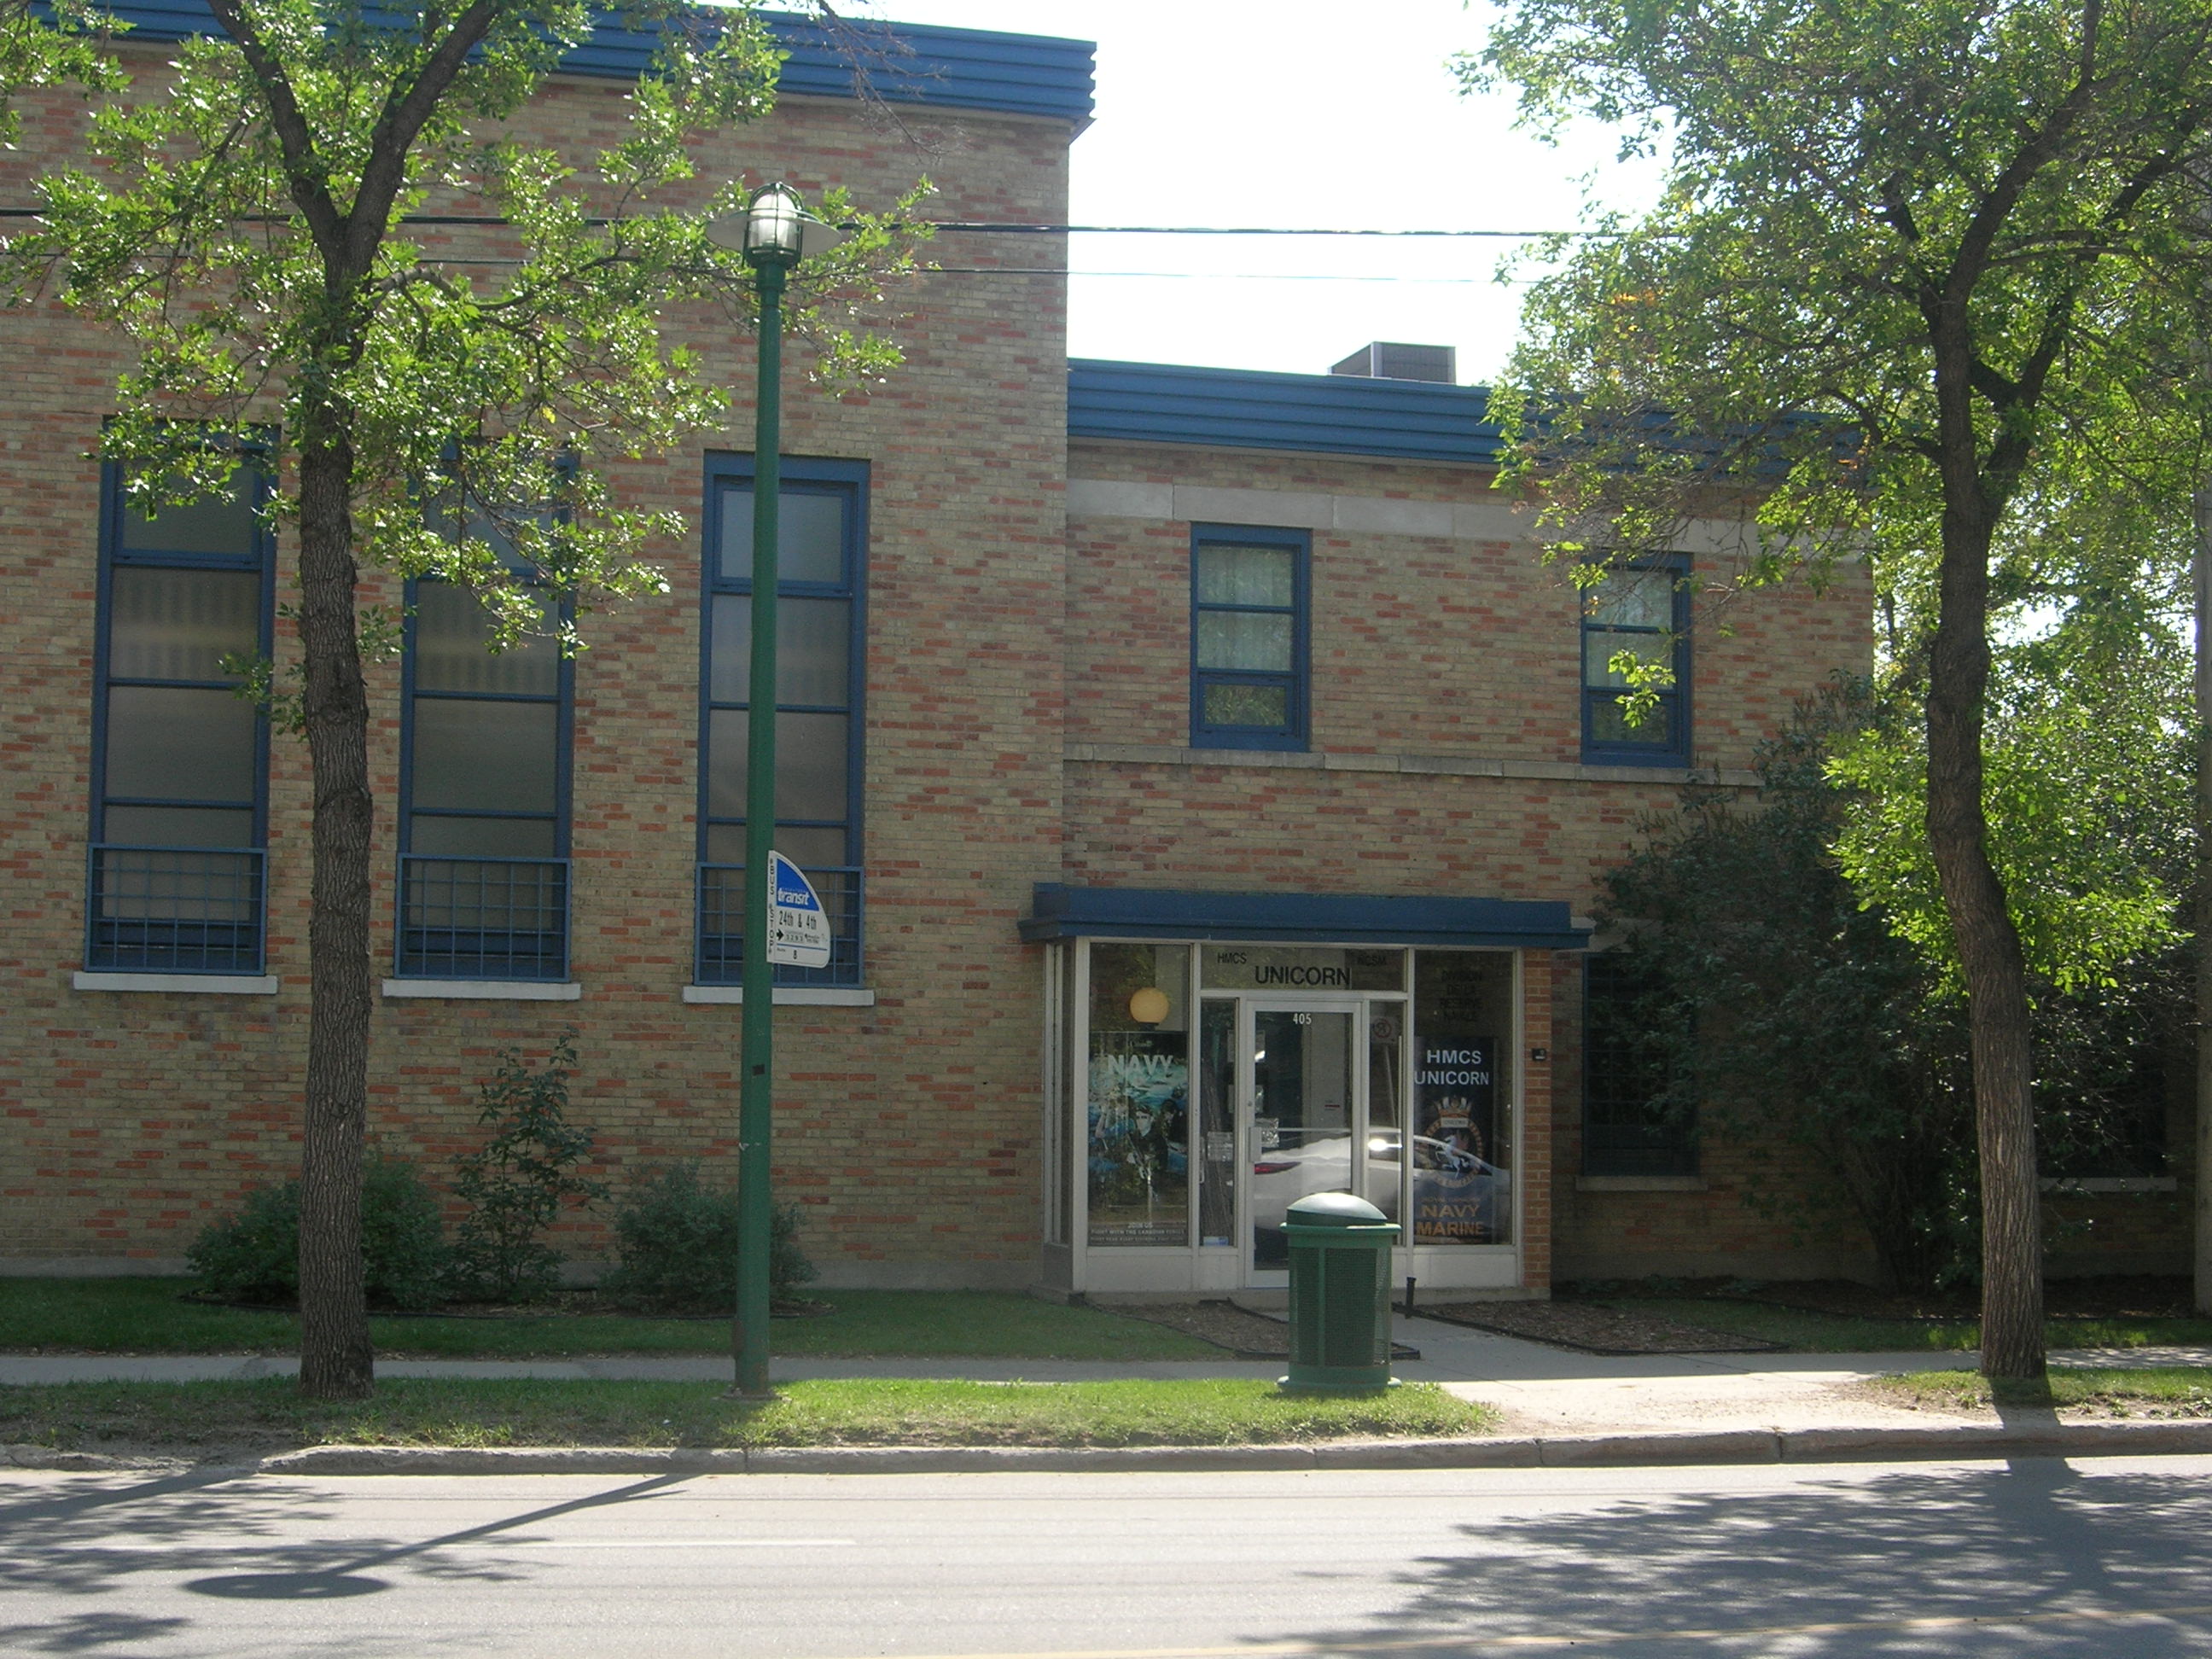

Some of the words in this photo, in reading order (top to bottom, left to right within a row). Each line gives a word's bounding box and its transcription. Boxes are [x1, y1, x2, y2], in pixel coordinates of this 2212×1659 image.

[777, 887, 810, 905] transit
[779, 910, 794, 927] 24th
[806, 914, 817, 929] 4th
[1217, 952, 1248, 963] HMCS
[1254, 965, 1351, 986] UNICORN
[1292, 1013, 1313, 1025] 405
[1108, 1054, 1173, 1076] NAVY
[1426, 1049, 1482, 1065] HMCS
[1413, 1070, 1489, 1086] UNICORN
[1421, 1204, 1481, 1218] NAVY
[1417, 1221, 1485, 1236] MARINE
